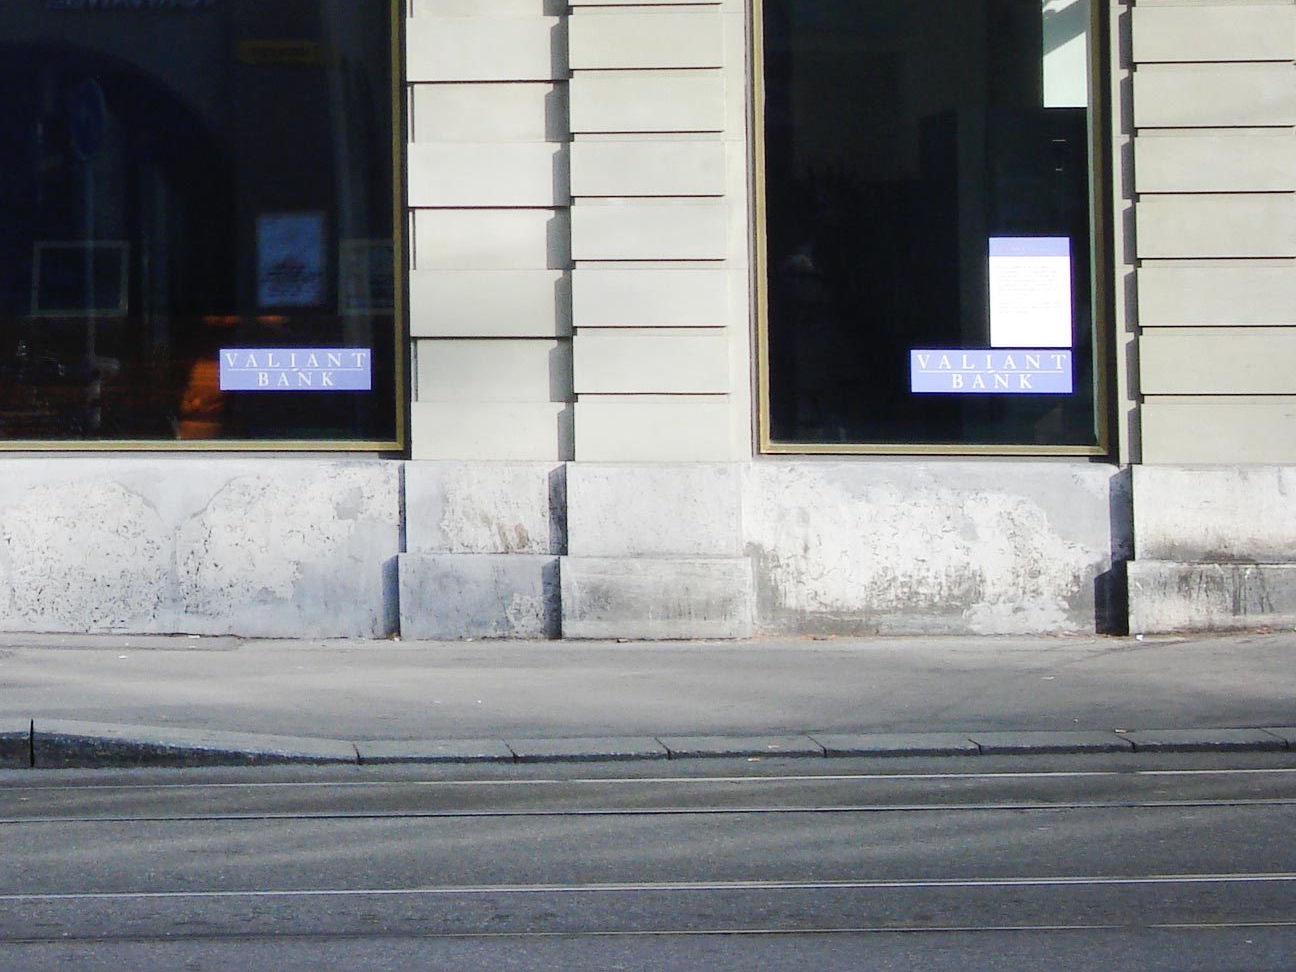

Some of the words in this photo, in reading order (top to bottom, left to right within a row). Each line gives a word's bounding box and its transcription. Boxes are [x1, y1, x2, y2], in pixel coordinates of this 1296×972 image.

[225, 352, 366, 368] VALIANT
[917, 354, 1067, 370] VALIANT
[258, 371, 335, 387] BANK
[951, 373, 1033, 389] BANK
